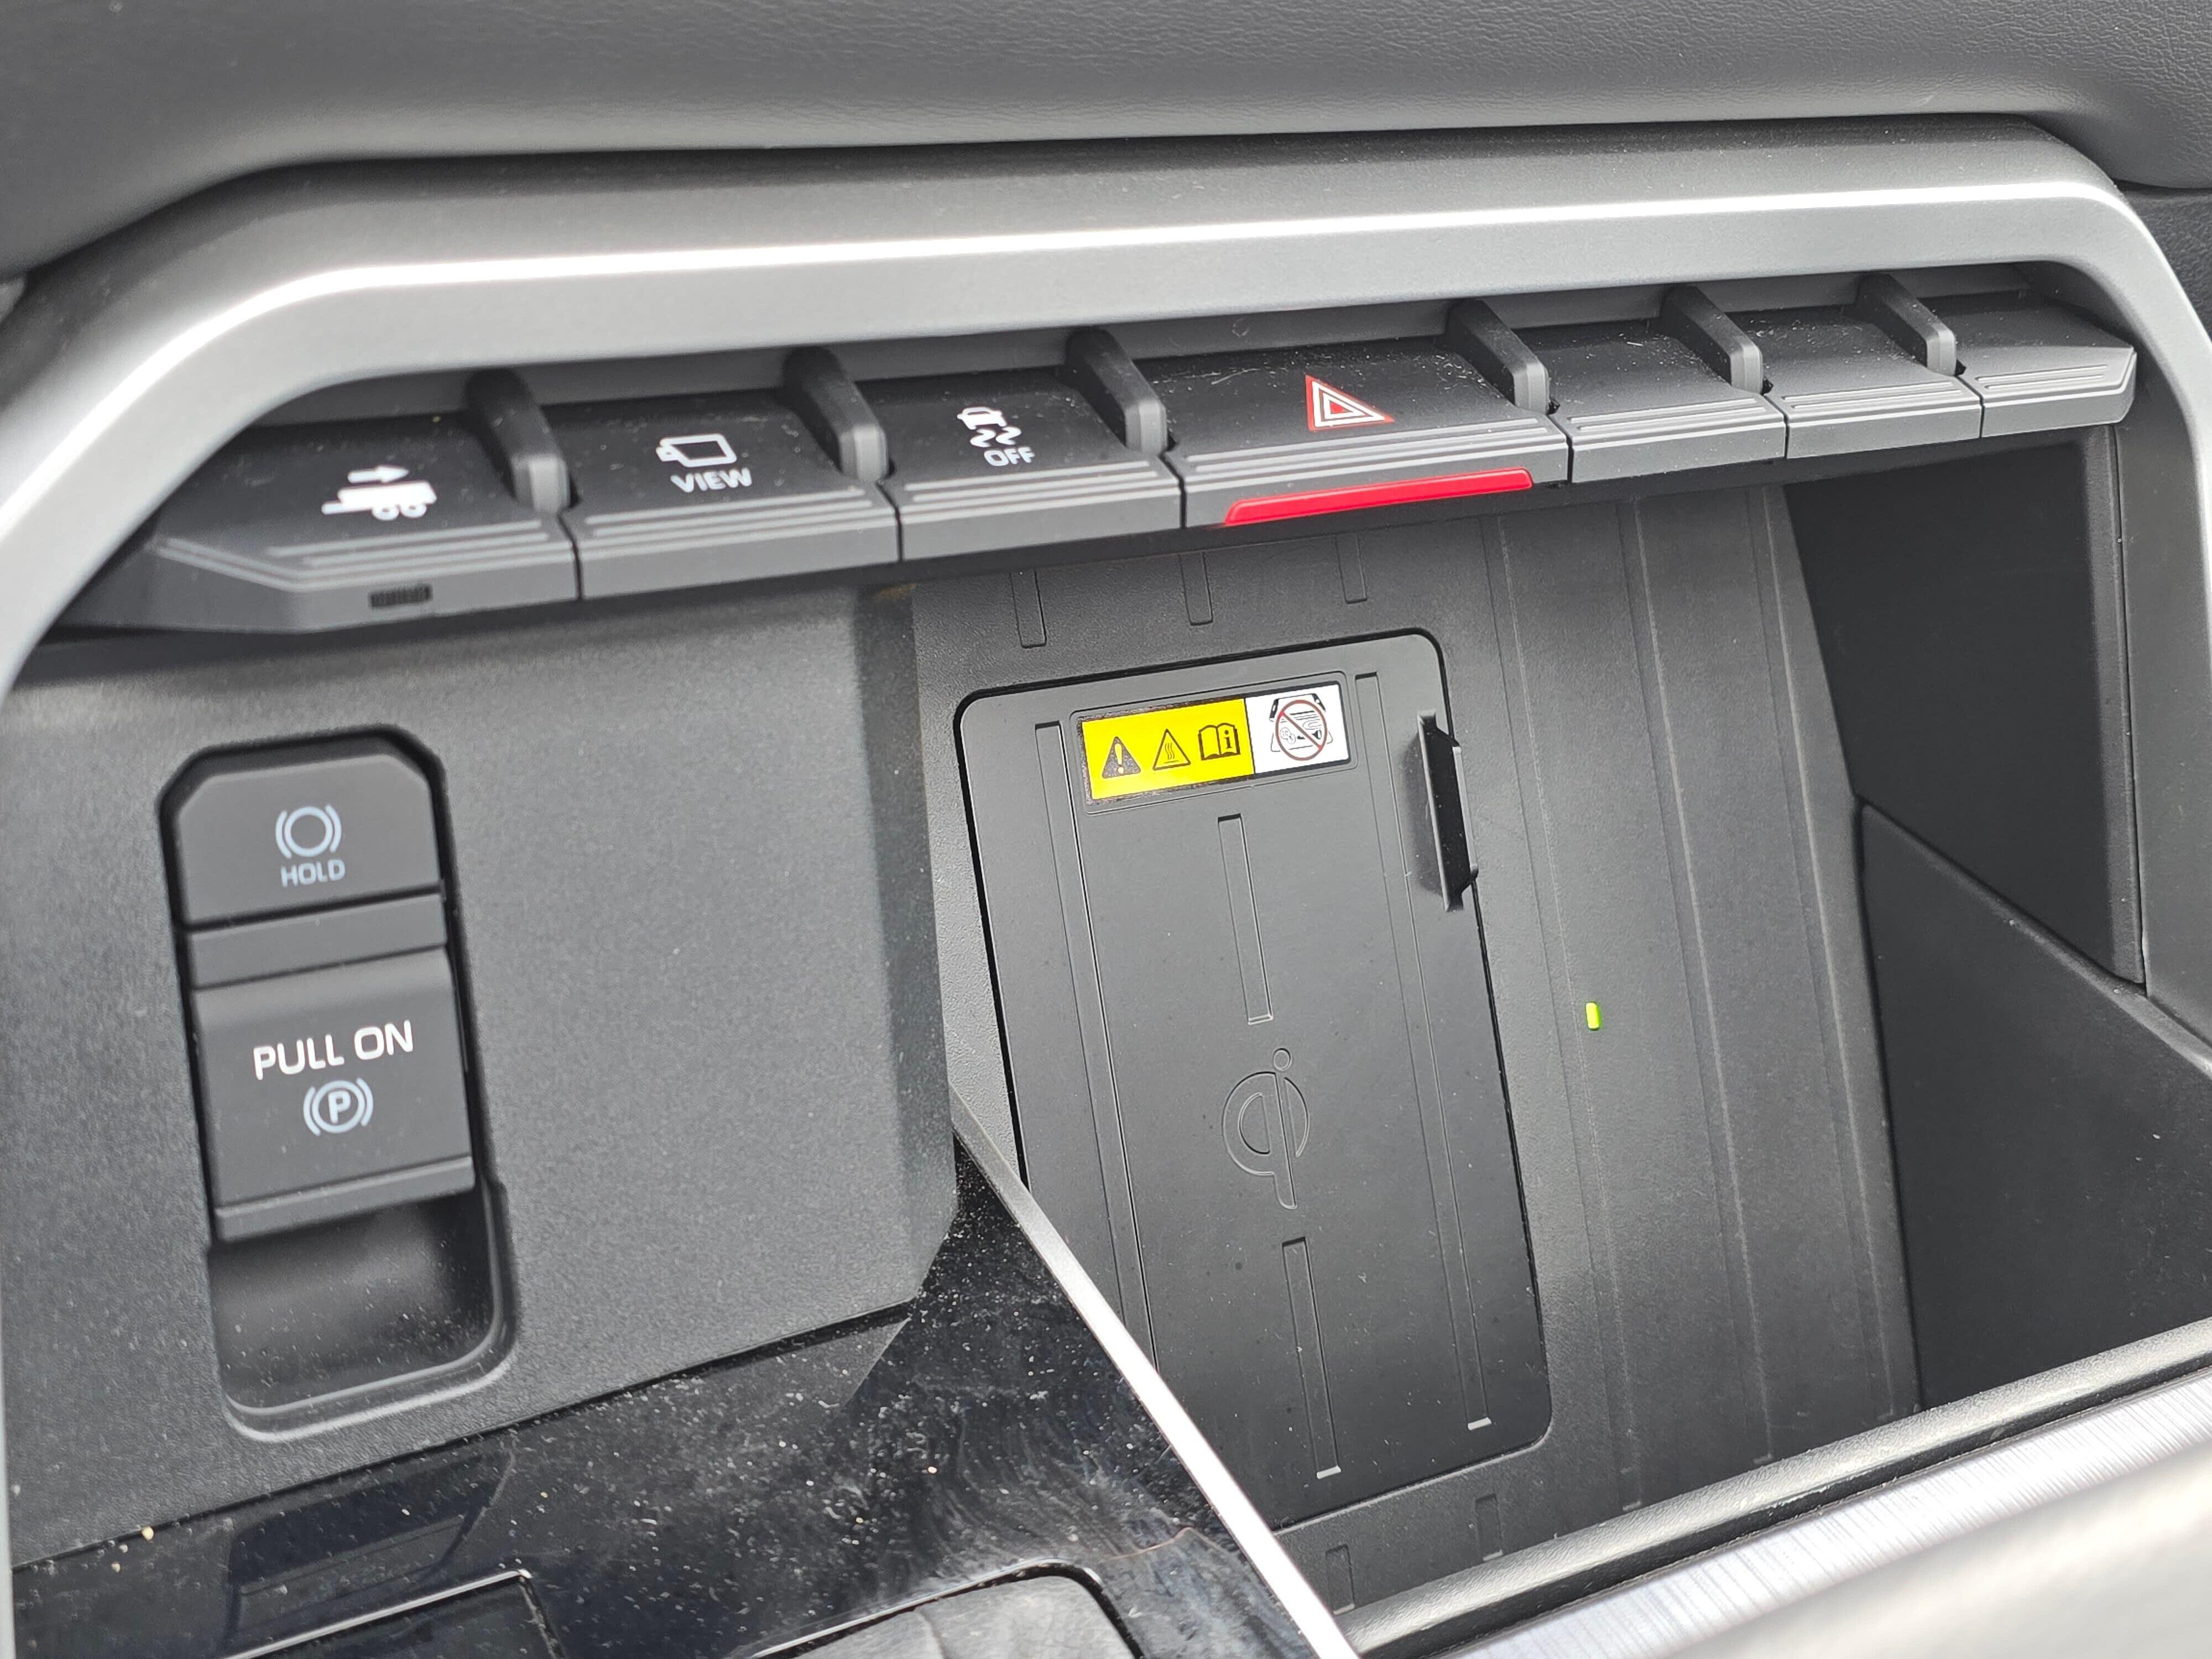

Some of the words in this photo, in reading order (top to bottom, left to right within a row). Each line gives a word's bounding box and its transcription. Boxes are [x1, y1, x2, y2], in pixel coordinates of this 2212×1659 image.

[984, 446, 1035, 466] OFF
[670, 467, 752, 493] VIEW
[280, 859, 346, 887] HOLD
[253, 1034, 345, 1081] PULL
[354, 1020, 414, 1060] ON
